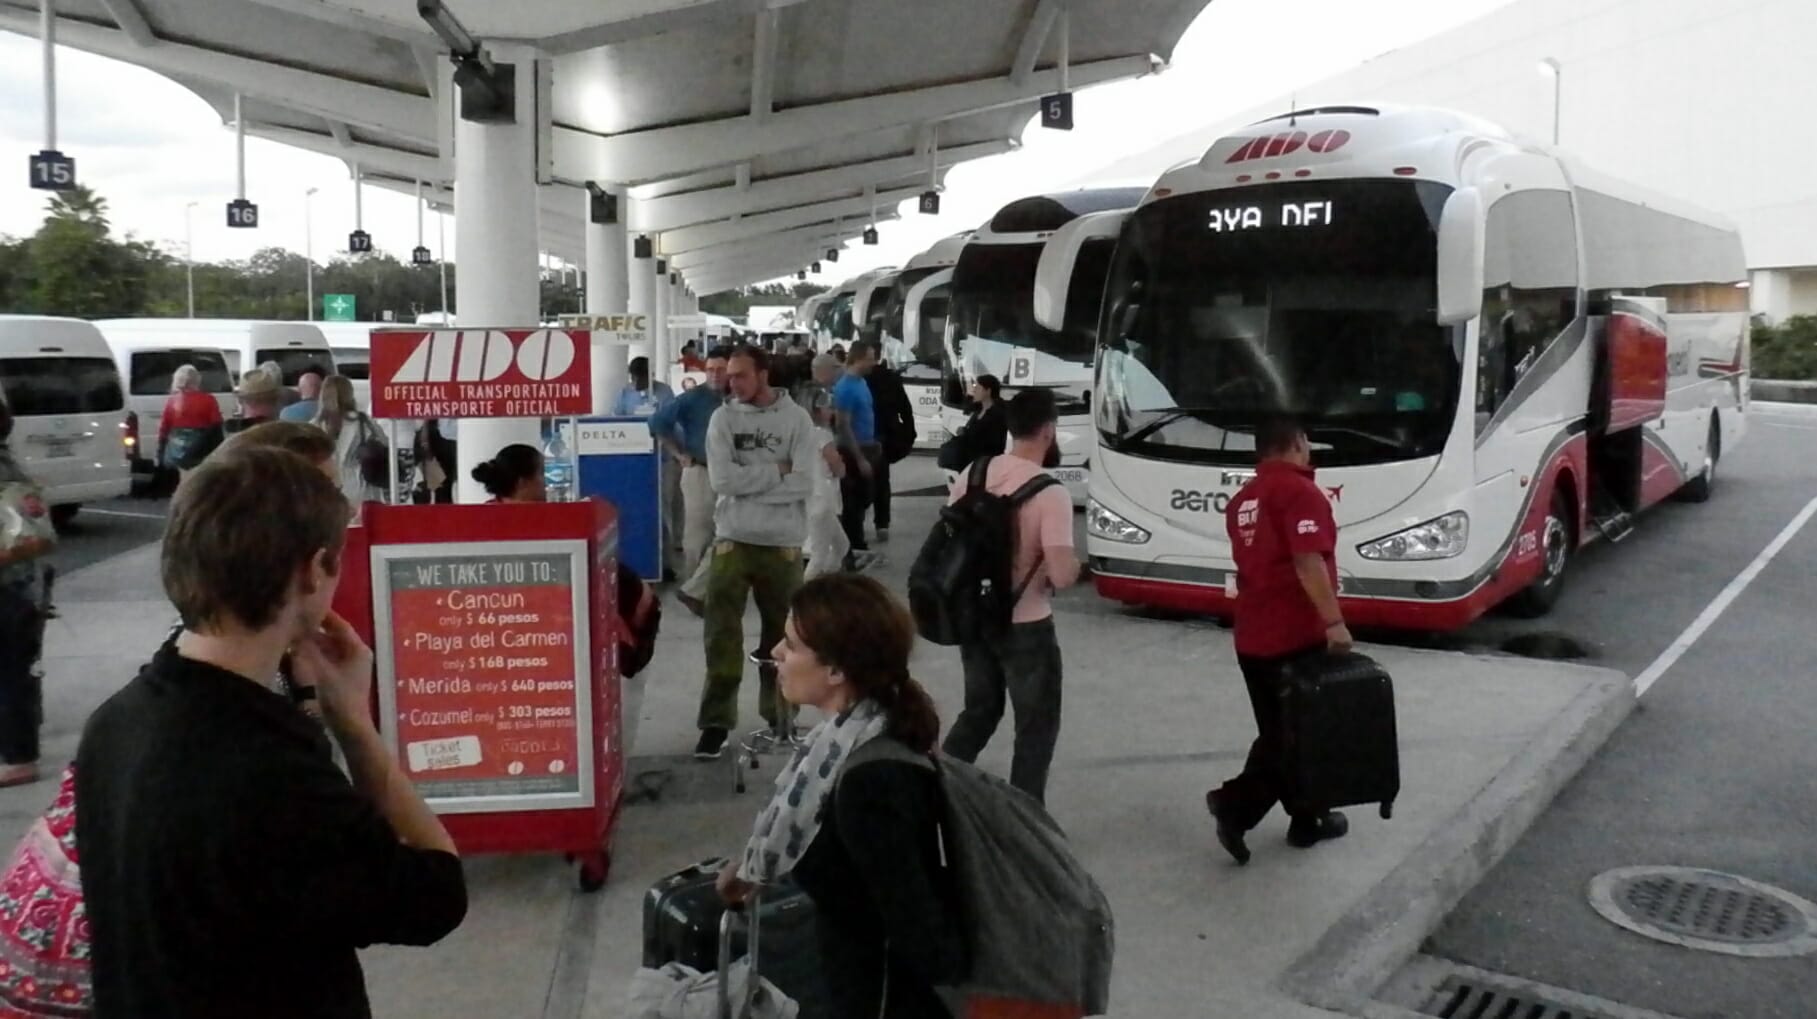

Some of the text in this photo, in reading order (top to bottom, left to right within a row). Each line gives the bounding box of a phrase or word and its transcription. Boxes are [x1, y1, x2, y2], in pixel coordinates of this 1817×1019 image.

[1050, 101, 1061, 119] 5
[1224, 129, 1351, 164] ADO
[36, 162, 70, 183] 15
[231, 208, 255, 223] 16
[352, 238, 369, 249] 17
[390, 330, 575, 383] ADO
[1015, 358, 1030, 378] B
[384, 383, 581, 401] OFFICIAL TRANSPORTATION
[406, 399, 561, 416] TRANSPORTE OFICIAL
[582, 430, 627, 440] DELTA
[417, 561, 557, 585] WE TAKE YOU TO:
[447, 589, 525, 610] Cancun
[439, 614, 462, 626] only
[478, 613, 496, 624] 66
[498, 612, 540, 626] pesos
[415, 629, 568, 654] Playa del Carmen
[442, 659, 466, 672] only
[479, 656, 504, 668] 168
[507, 655, 548, 670] pesos
[408, 677, 471, 694] Merida
[475, 680, 499, 694] only
[511, 679, 535, 692] 640
[537, 679, 574, 694] pesos
[410, 707, 472, 727] Cozumel
[474, 711, 494, 724] only
[508, 705, 532, 718] 303
[535, 705, 571, 720] pesos
